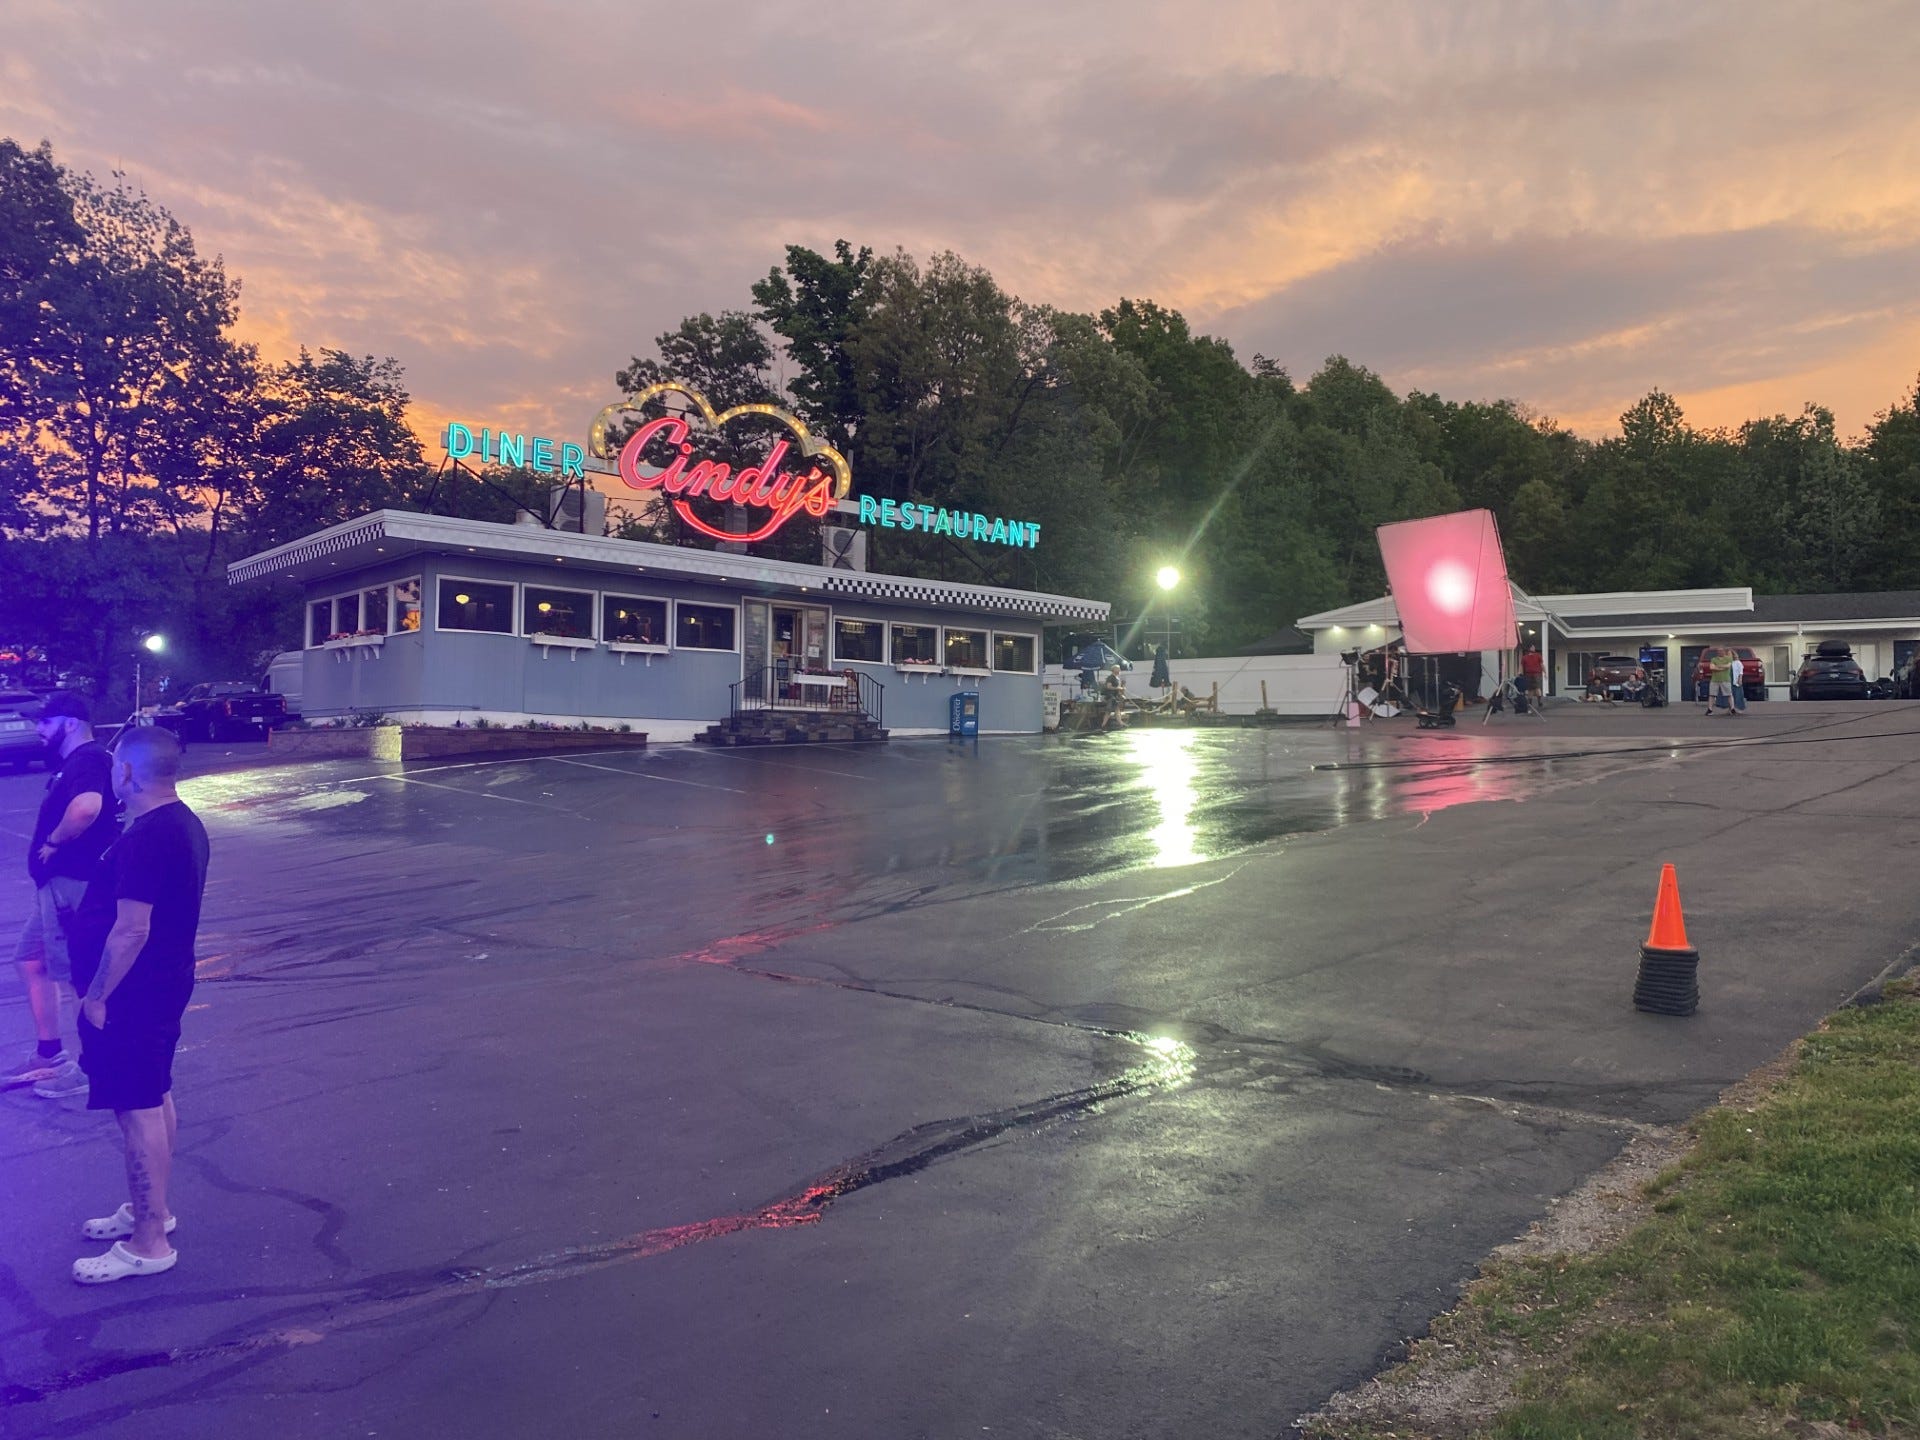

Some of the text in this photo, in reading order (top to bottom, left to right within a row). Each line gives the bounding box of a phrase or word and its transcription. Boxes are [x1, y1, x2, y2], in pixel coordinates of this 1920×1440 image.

[448, 422, 585, 479] DINER
[619, 417, 838, 542] Cindy's
[859, 494, 1042, 549] RESTAURANT
